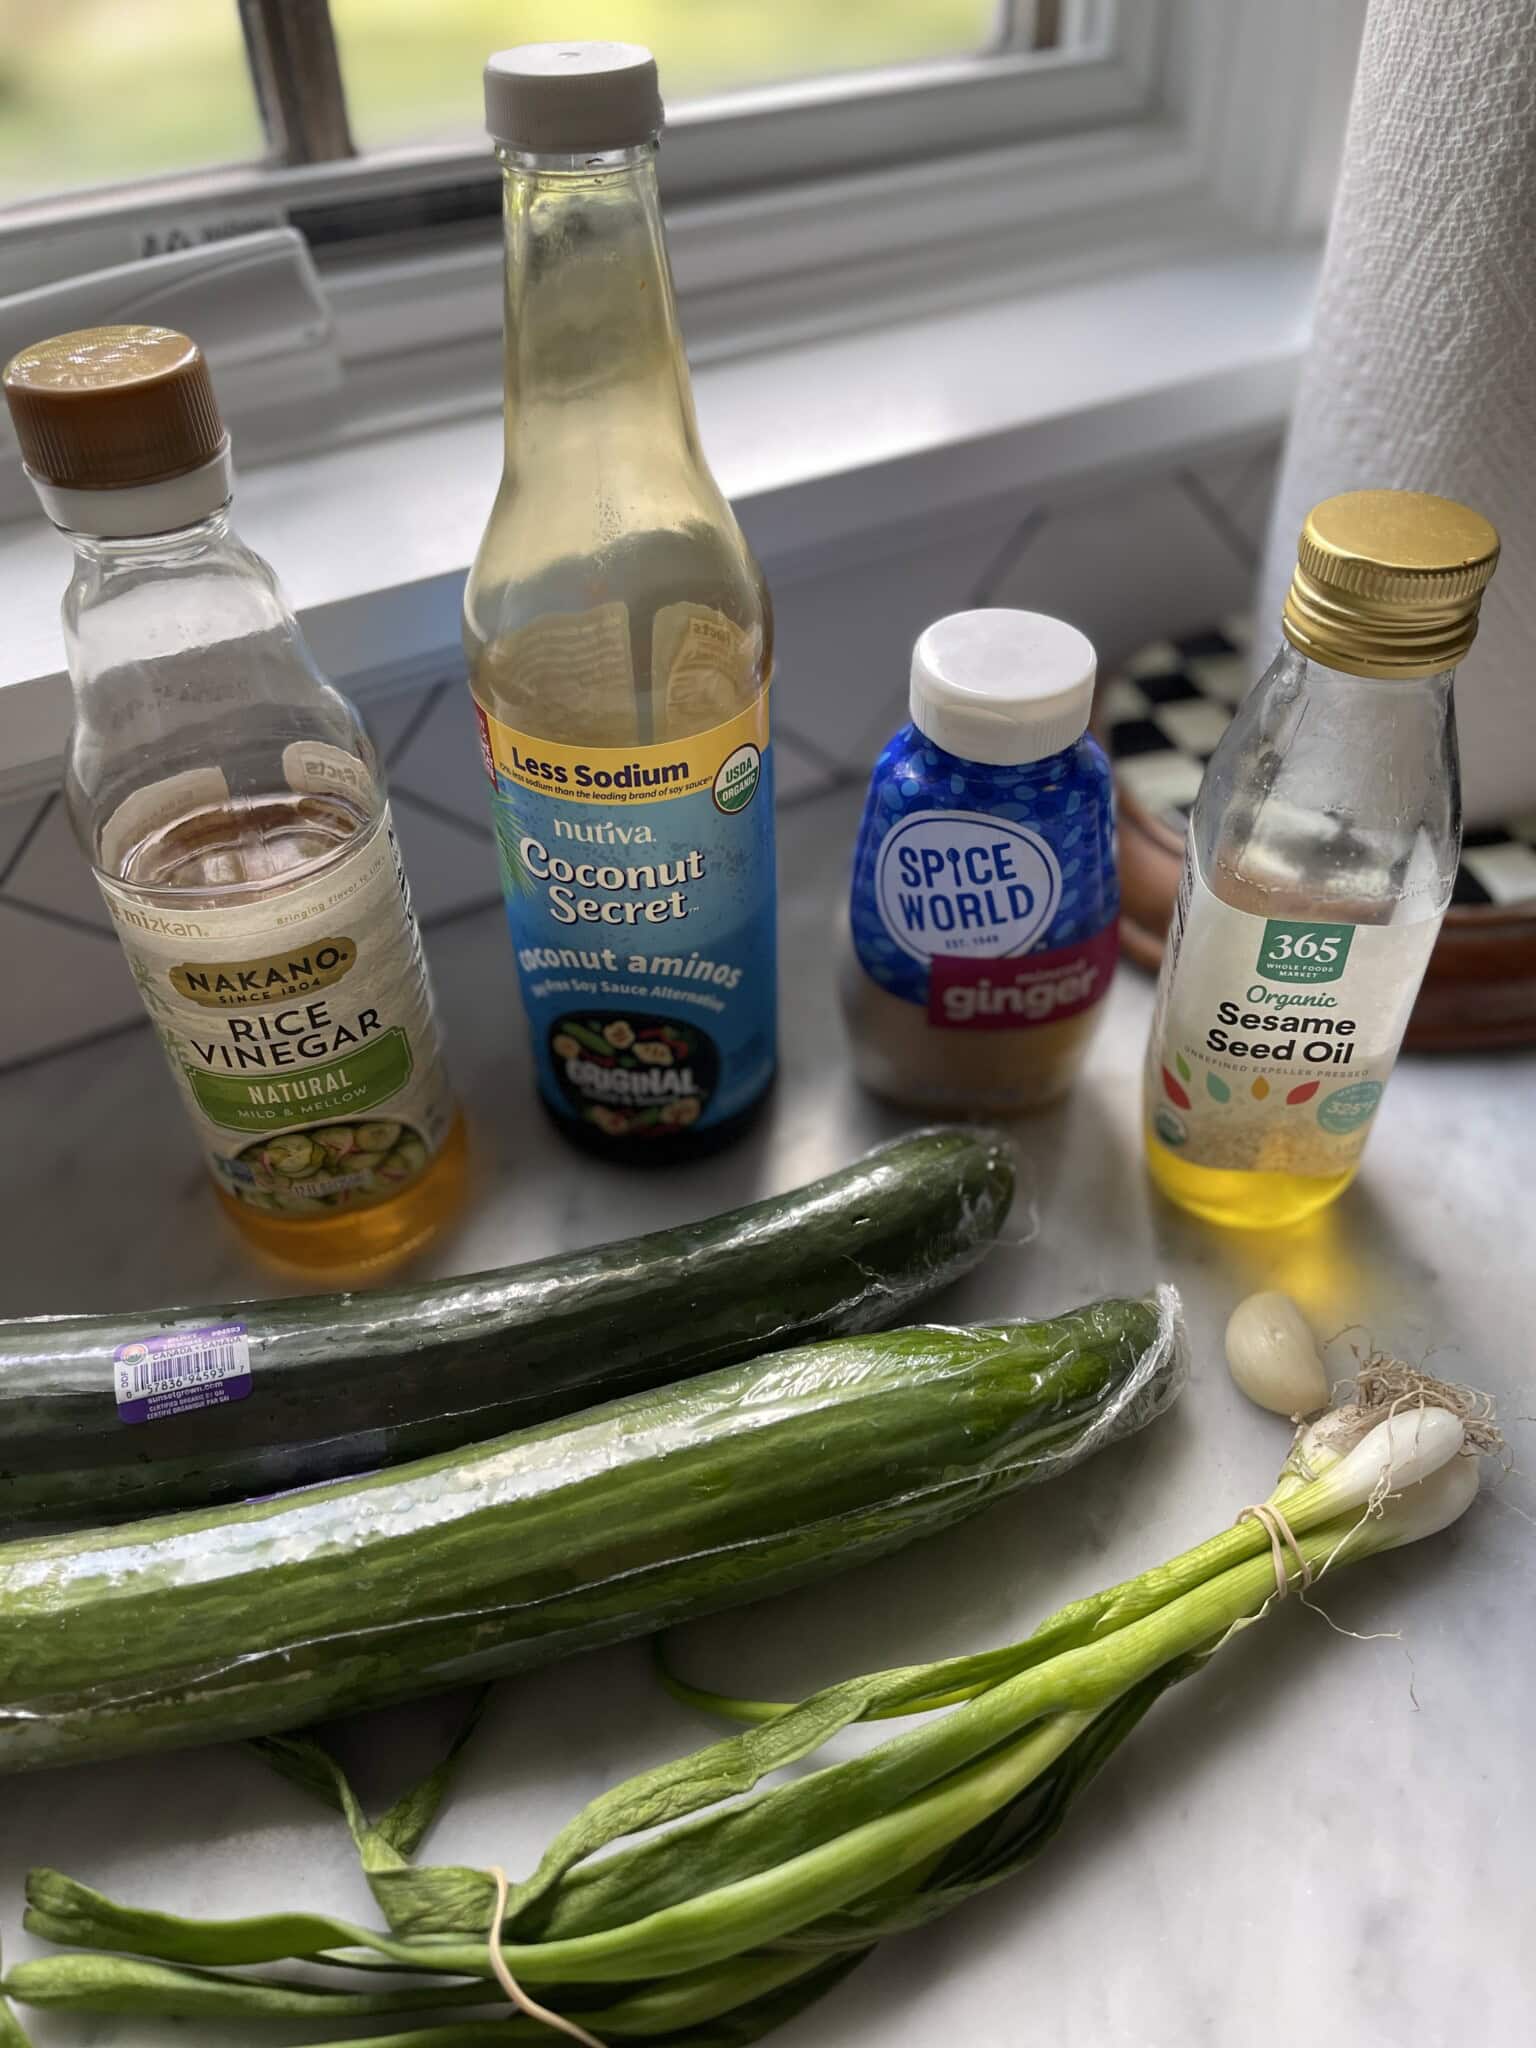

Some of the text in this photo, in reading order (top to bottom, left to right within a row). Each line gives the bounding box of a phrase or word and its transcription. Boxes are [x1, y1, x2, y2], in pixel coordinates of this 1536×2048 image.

[512, 746, 569, 784] Less
[574, 761, 690, 789] Sodium
[725, 757, 753, 784] USDA
[525, 777, 554, 794] sodium
[554, 784, 575, 798] than
[576, 787, 591, 800] the
[591, 790, 628, 803] leading
[628, 788, 657, 801] brand
[658, 786, 669, 797] of
[668, 785, 684, 795] soy
[721, 772, 756, 803] ORGANIC
[553, 817, 653, 846] nutiva
[518, 836, 705, 892] Coconut
[898, 842, 1017, 889] SPICE
[275, 902, 327, 926] Bringing
[549, 885, 689, 925] Secret
[897, 883, 1036, 932] WORLD
[123, 908, 203, 937] mizkan
[1268, 932, 1342, 963] 365
[185, 946, 339, 993] NAKANO
[627, 952, 744, 989] aminos
[1266, 962, 1334, 973] WHOLE FOODS
[1279, 970, 1318, 978] MARKET
[218, 977, 322, 1005] SINCE 1804
[600, 980, 648, 997] Sauce
[942, 965, 1099, 1021] ginger
[1246, 984, 1338, 1011] Organic
[228, 1000, 332, 1043] RICE
[1216, 1001, 1357, 1037] Sesame
[190, 1007, 383, 1069] VINEGAR
[1206, 1028, 1356, 1065] Seed Oil
[237, 1108, 276, 1120] MILD
[300, 1084, 368, 1114] MELLOW
[247, 1068, 353, 1106] NATURAL
[152, 1345, 193, 1361] CANADA
[201, 1336, 242, 1350] CANADA
[147, 1379, 182, 1395] 57836
[188, 1368, 225, 1385] 94593
[239, 1365, 245, 1373] 7
